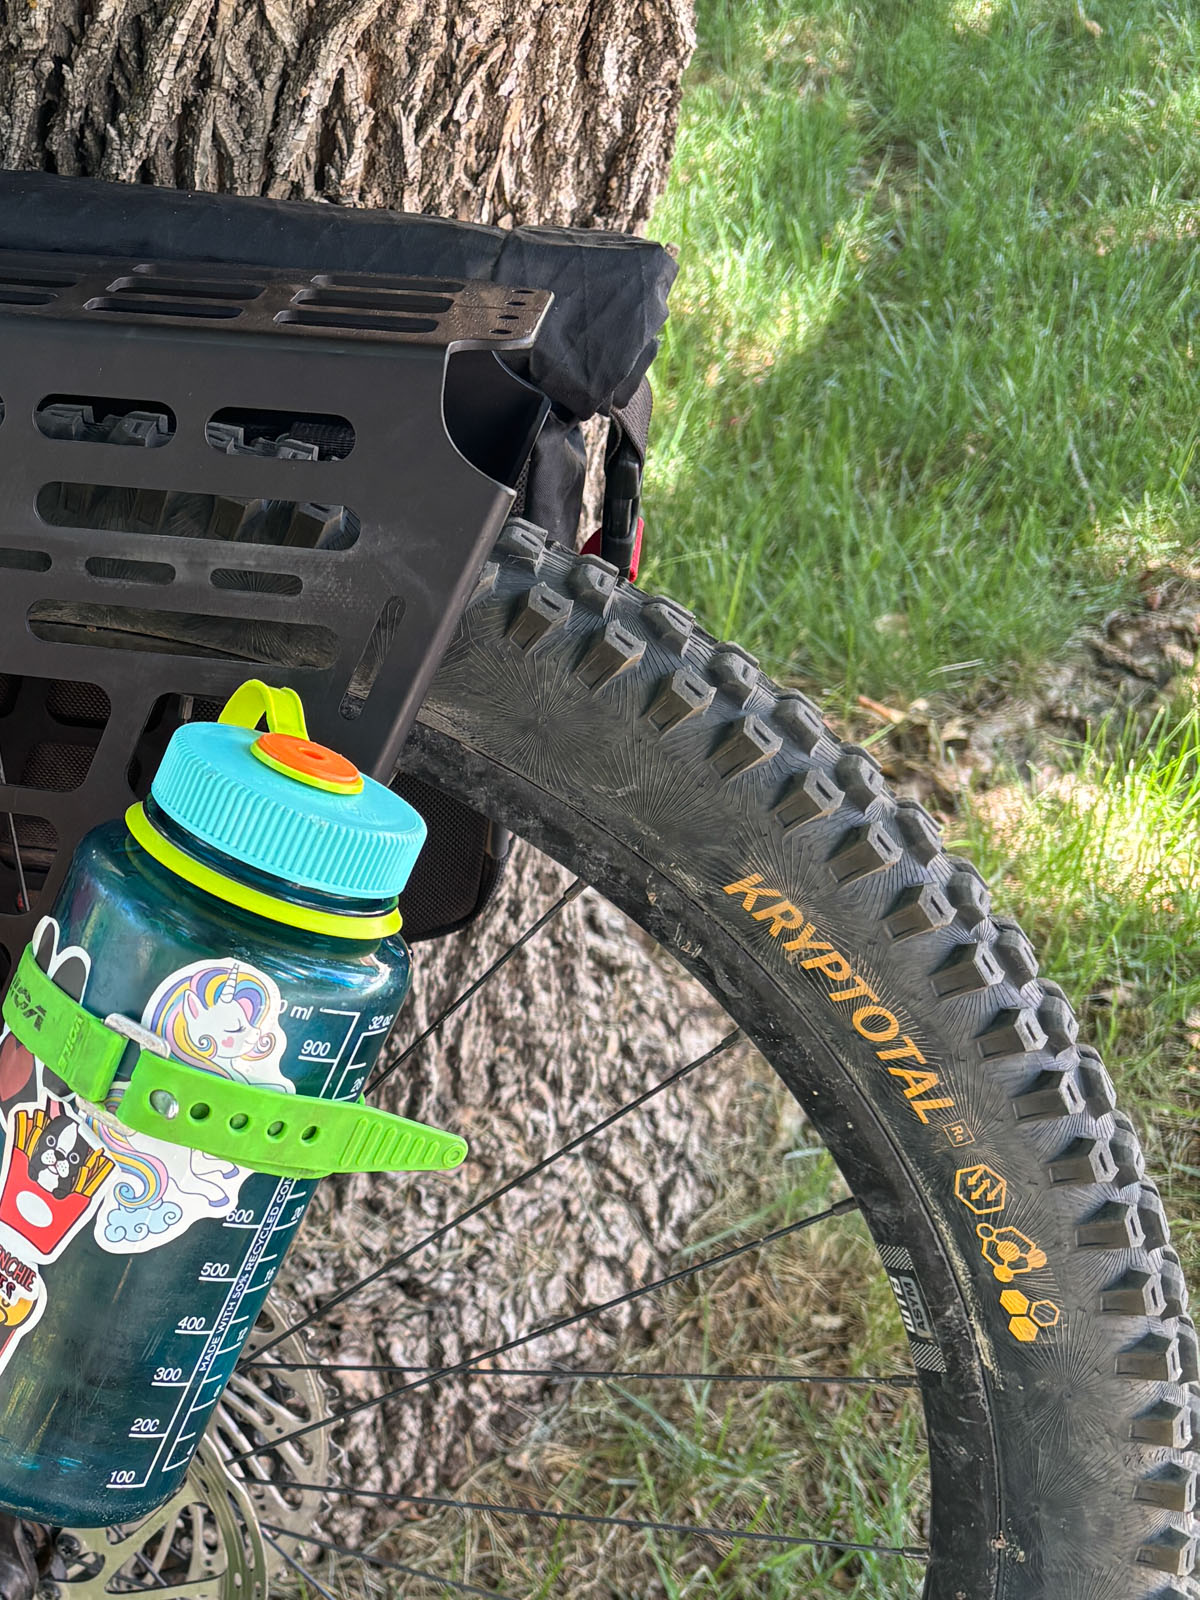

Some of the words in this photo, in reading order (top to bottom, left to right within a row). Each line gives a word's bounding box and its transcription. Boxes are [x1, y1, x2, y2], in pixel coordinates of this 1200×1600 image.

[722, 873, 955, 1124] KRYPTOTAL
[301, 1040, 331, 1057] 900
[225, 1208, 255, 1224] 600
[201, 1262, 230, 1278] 500
[199, 1337, 221, 1372] MADE
[216, 1302, 236, 1334] WITH
[232, 1273, 249, 1299] 50%
[245, 1206, 280, 1271] RECYCLED
[903, 1281, 927, 1332] ASYM
[177, 1316, 206, 1330] 400
[153, 1367, 182, 1381] 300
[110, 1470, 136, 1483] 100
